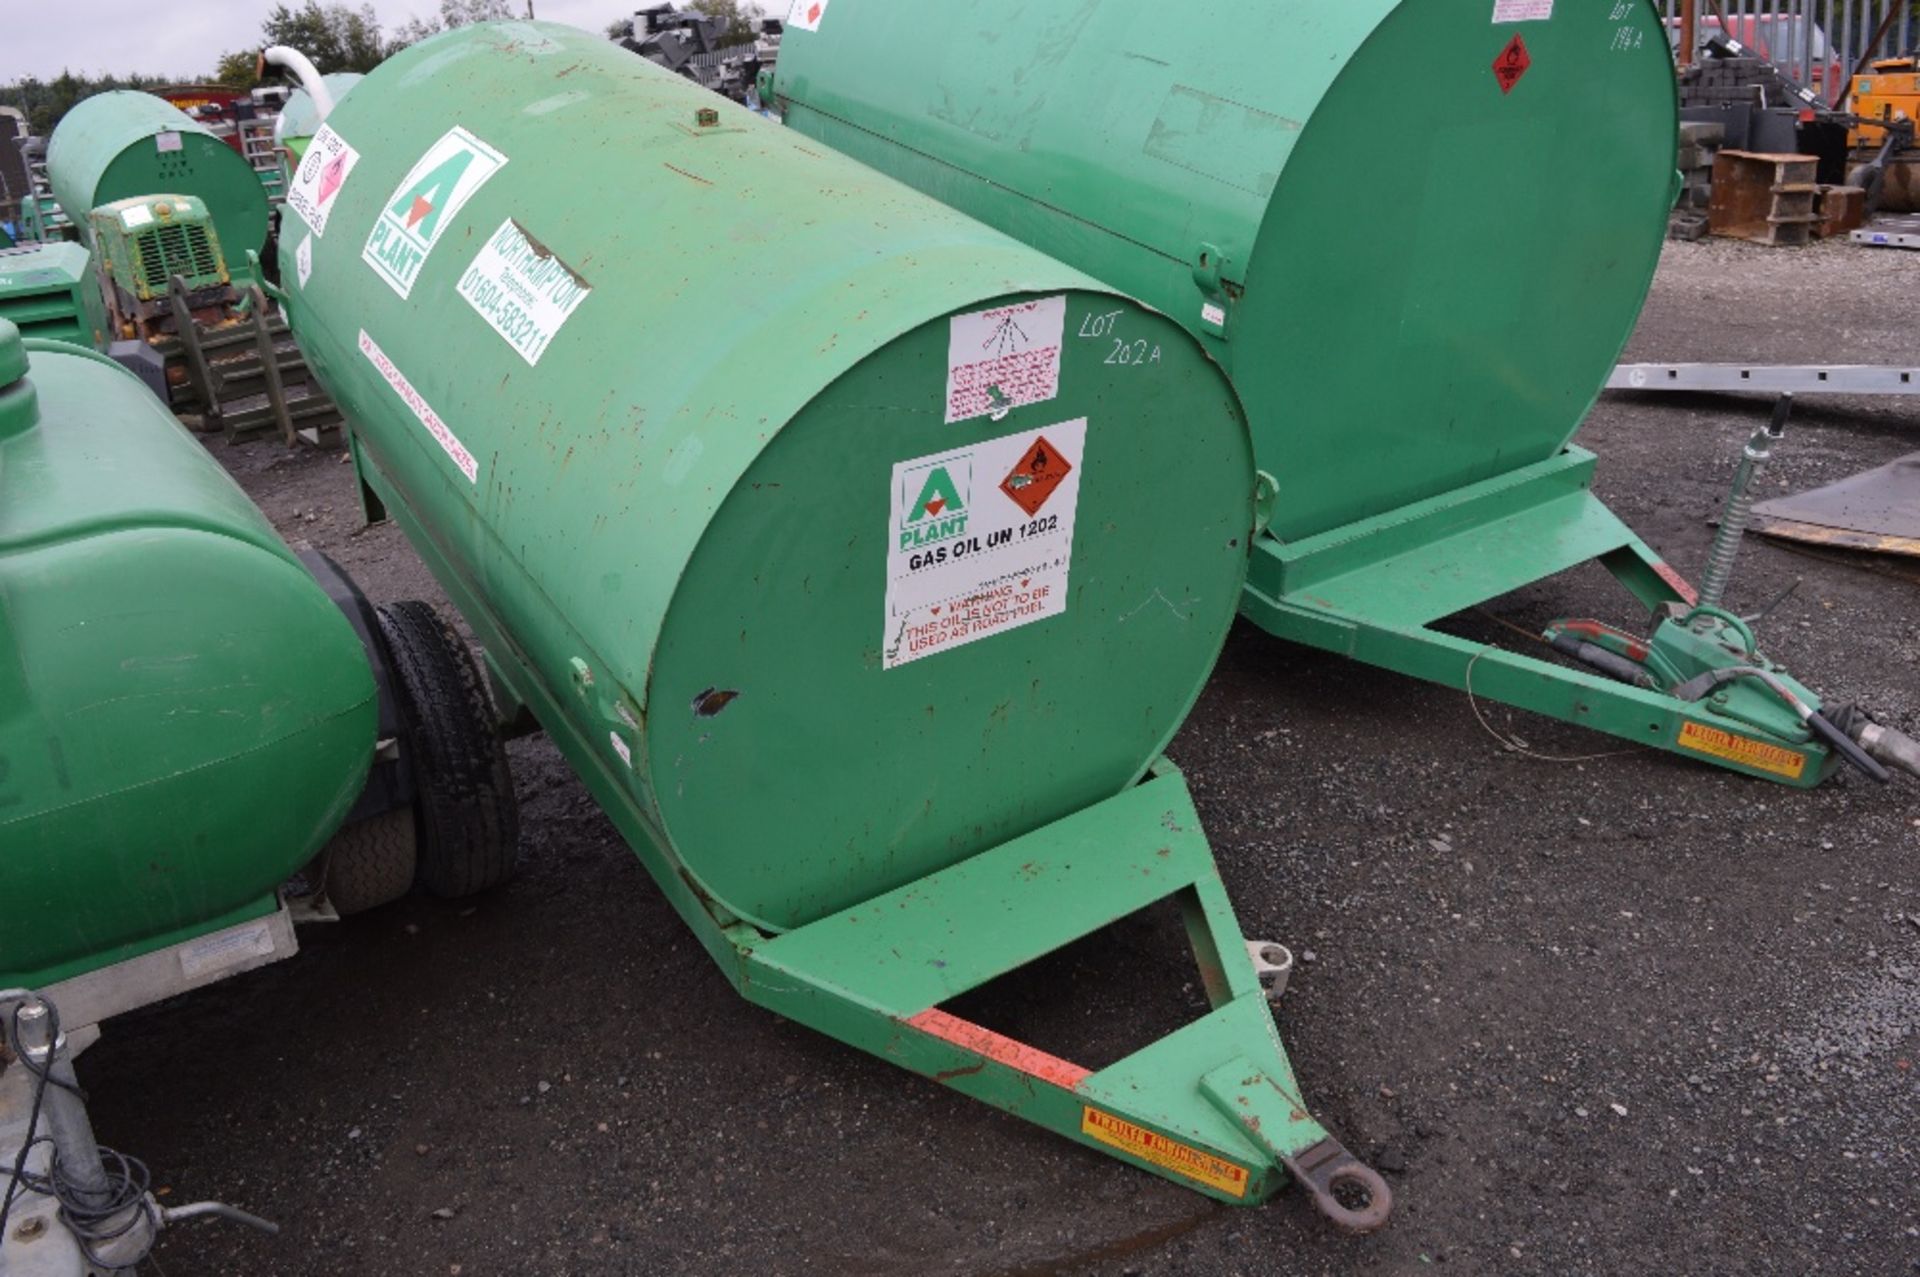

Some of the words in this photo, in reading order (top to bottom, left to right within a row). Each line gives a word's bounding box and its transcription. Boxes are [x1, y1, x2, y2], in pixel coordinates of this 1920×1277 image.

[390, 149, 475, 242] A
[369, 219, 423, 281] PLANT
[462, 267, 548, 358] 01604-583211
[1078, 308, 1124, 337] LOT
[907, 466, 965, 523] A
[900, 515, 968, 549] PLANT
[909, 547, 947, 571] GAS
[952, 537, 981, 557] OIL
[986, 528, 1013, 548] UN
[1019, 515, 1058, 538] 1202
[906, 620, 938, 640] THIS
[940, 614, 963, 629] OIL
[964, 608, 981, 621] IS
[983, 599, 1008, 617] NOT
[1013, 592, 1029, 604] TO
[1032, 585, 1050, 600] BE
[909, 632, 947, 651] USED
[950, 624, 969, 640] AS
[972, 612, 1010, 632] ROAD
[1012, 601, 1046, 619] FUEL
[949, 585, 1013, 612] WARNING
[1093, 1111, 1143, 1142] TRAILER
